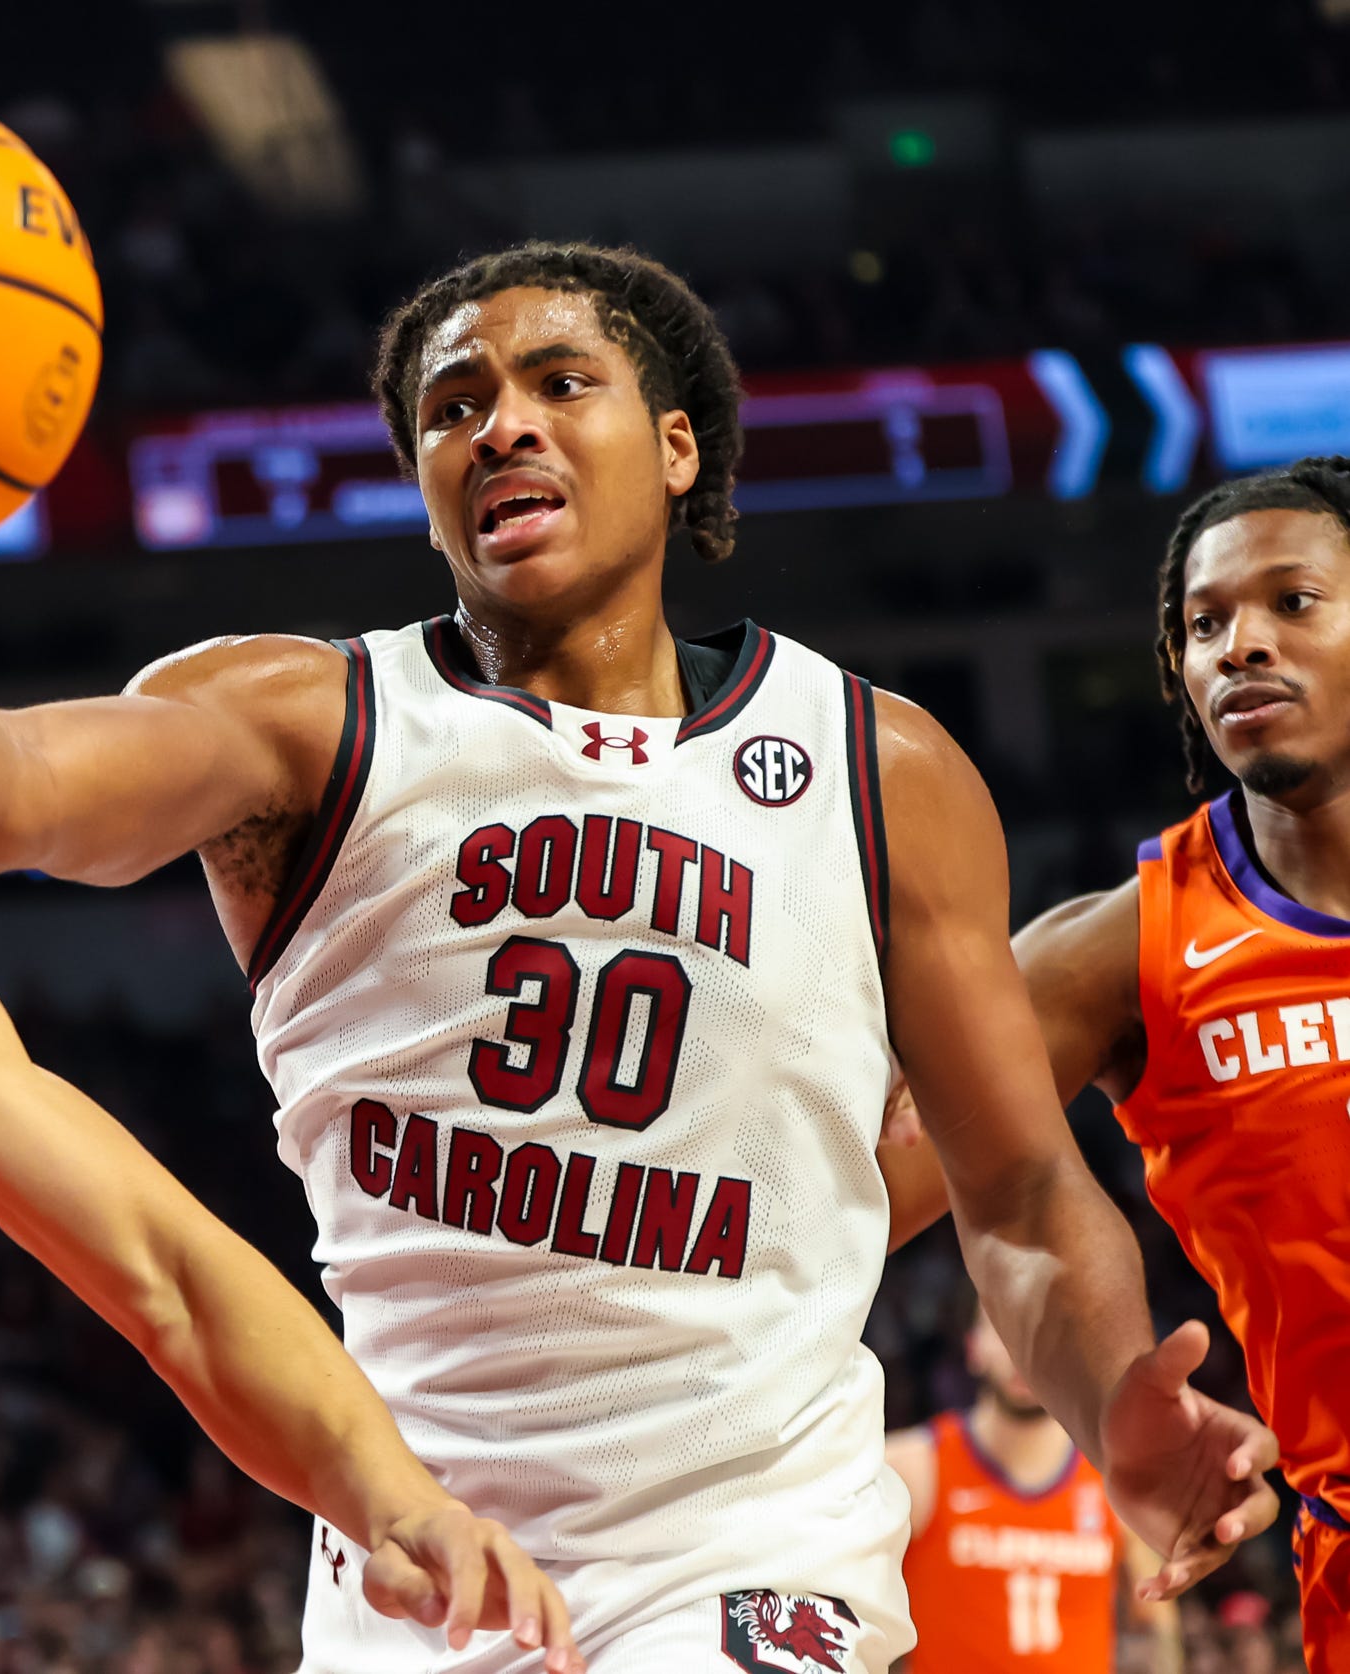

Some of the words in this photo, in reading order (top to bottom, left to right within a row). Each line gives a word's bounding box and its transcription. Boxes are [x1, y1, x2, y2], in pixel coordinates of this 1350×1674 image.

[741, 739, 806, 801] SEC
[450, 813, 754, 969] SOUTH
[468, 935, 693, 1131] 30
[351, 1097, 752, 1279] CAROLINA
